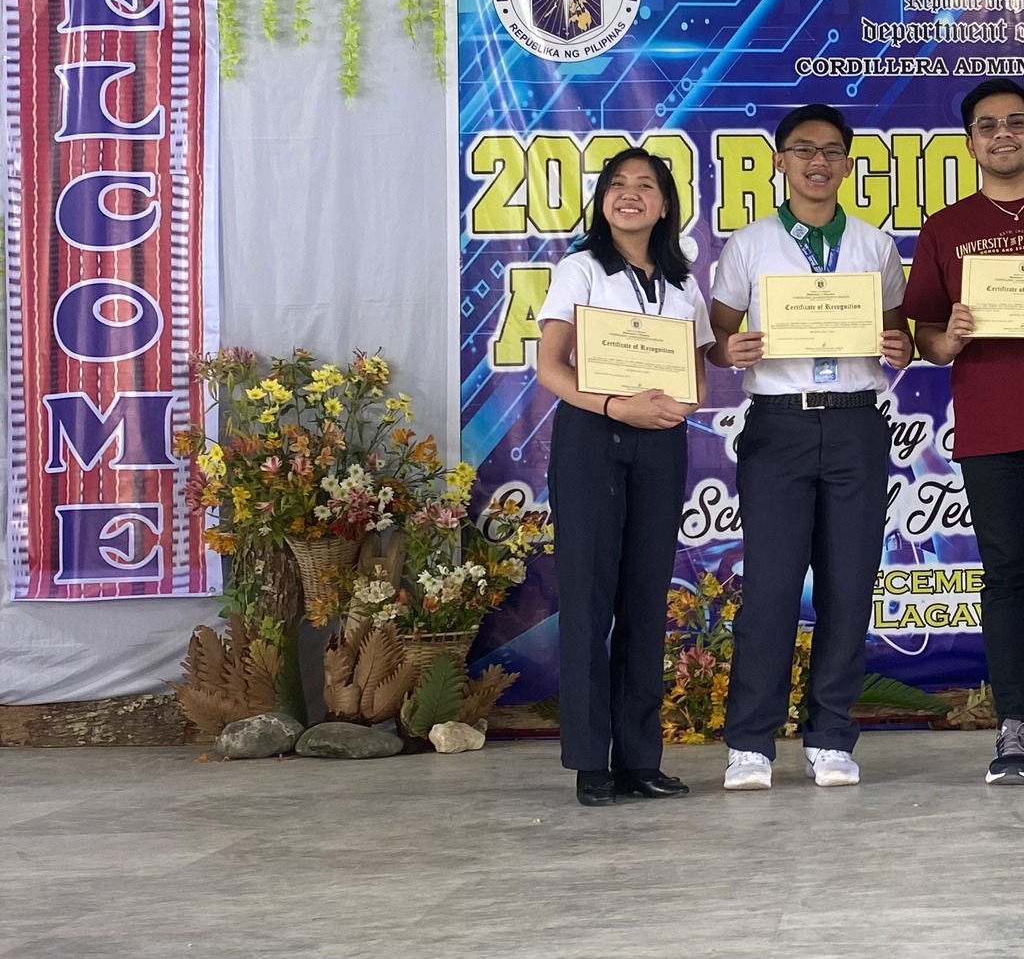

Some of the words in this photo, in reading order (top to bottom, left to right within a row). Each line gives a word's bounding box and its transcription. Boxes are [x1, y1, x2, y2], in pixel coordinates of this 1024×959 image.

[509, 23, 560, 58] REPUBLIKA
[564, 50, 580, 58] NG
[584, 22, 626, 55] PILIPINAS
[795, 56, 949, 76] CORDILLERA
[956, 236, 1010, 259] UNIVERSITY
